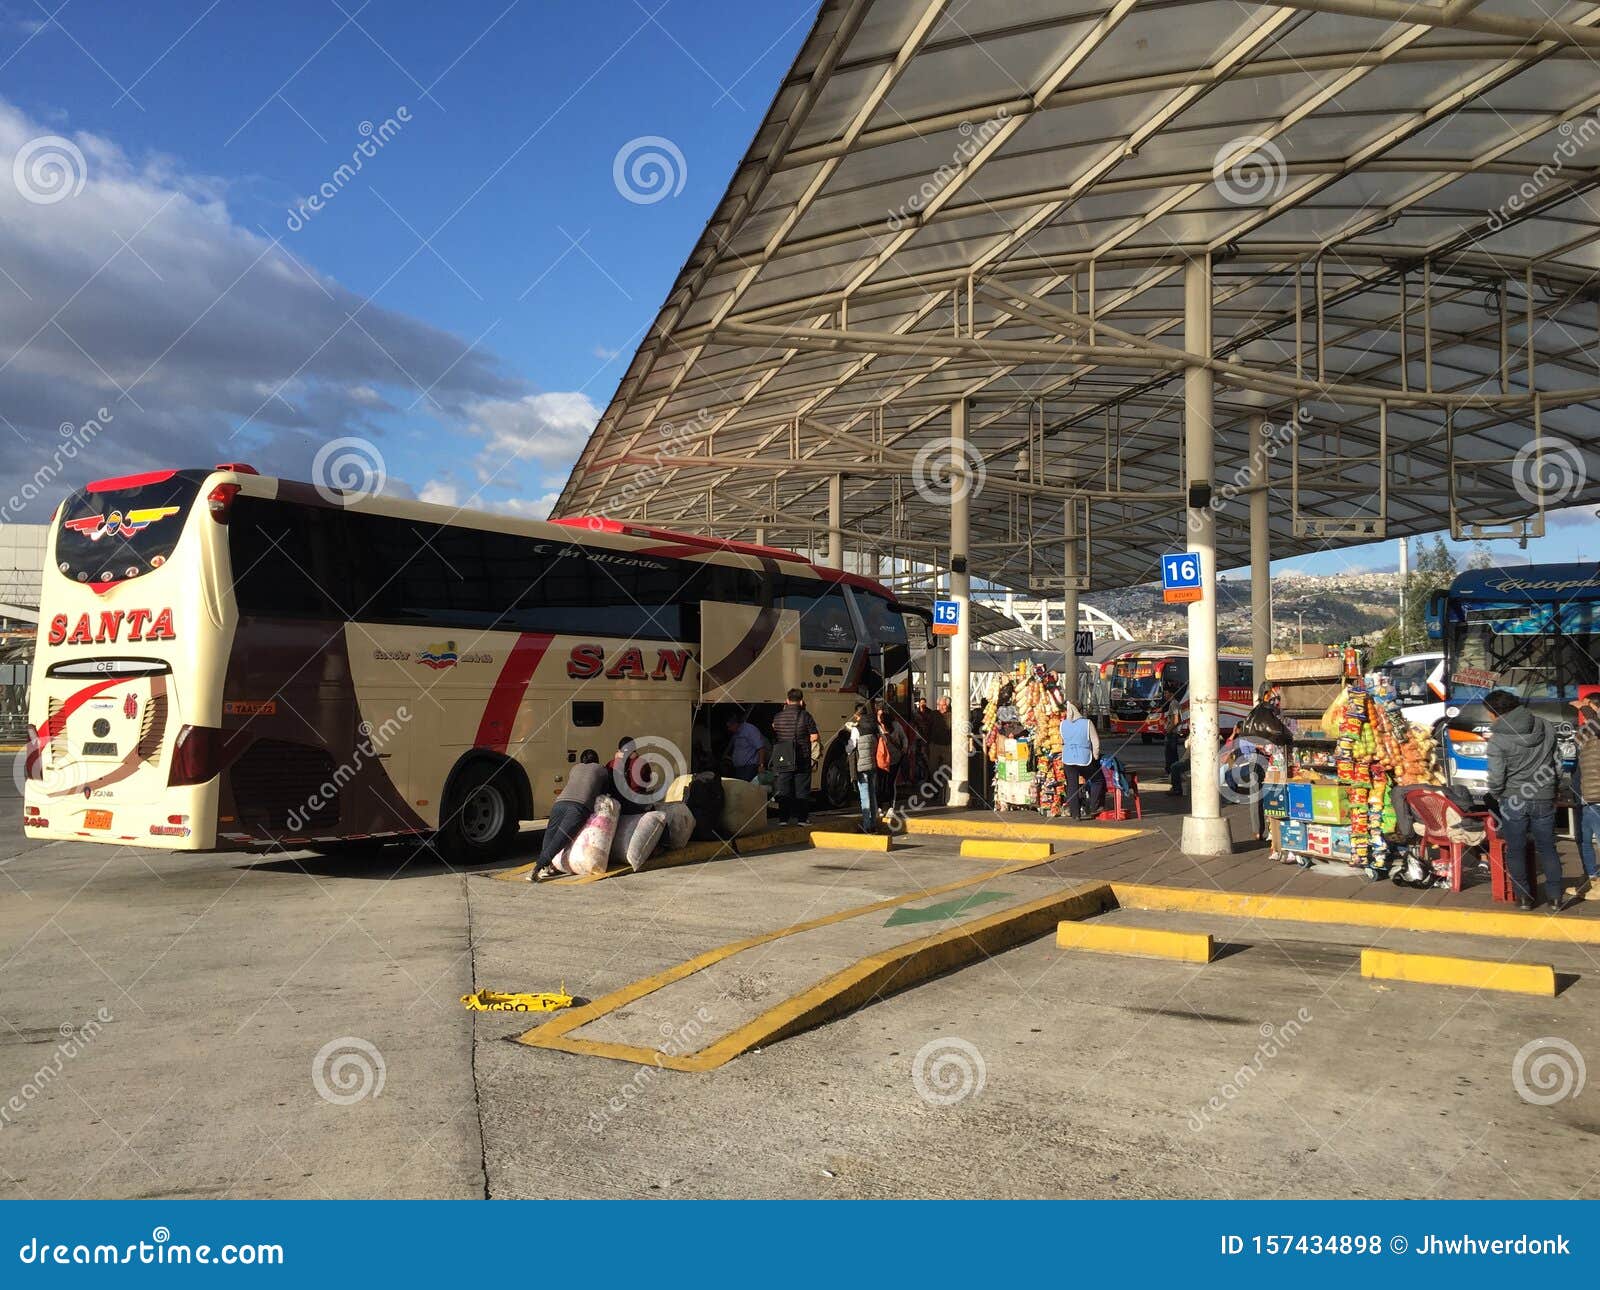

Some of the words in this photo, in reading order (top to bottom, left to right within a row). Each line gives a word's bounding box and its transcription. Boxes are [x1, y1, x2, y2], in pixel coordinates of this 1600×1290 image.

[1168, 561, 1196, 581] 16
[48, 607, 177, 647] SANTA
[938, 606, 956, 620] 15
[567, 643, 700, 682] SAN
